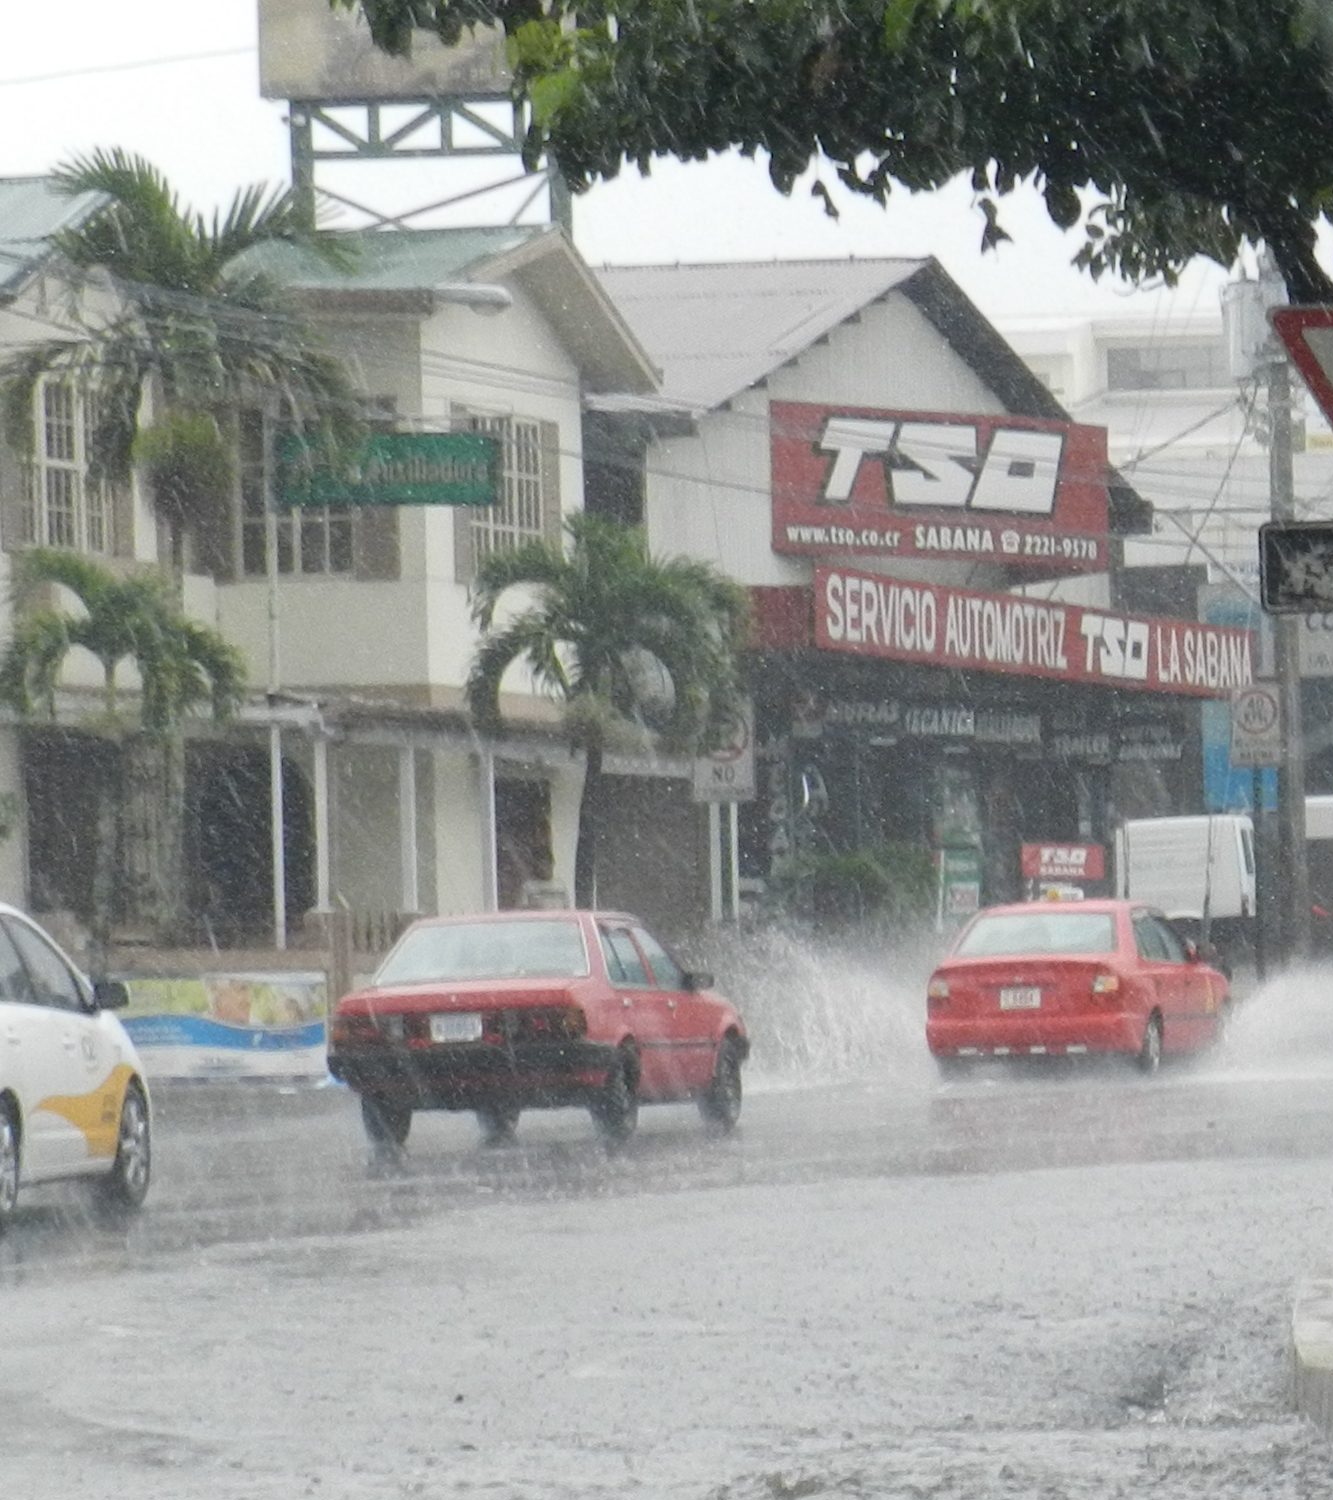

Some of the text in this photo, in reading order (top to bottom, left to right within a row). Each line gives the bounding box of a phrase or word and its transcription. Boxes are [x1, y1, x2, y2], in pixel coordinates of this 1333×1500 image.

[818, 415, 1064, 515] TSO
[786, 525, 901, 547] www.tso.co.cr
[915, 524, 995, 552] SABANA
[826, 573, 1253, 689] SERVICIO AUTOMOTRIZ TSO LA SABANA
[712, 766, 736, 783] NO
